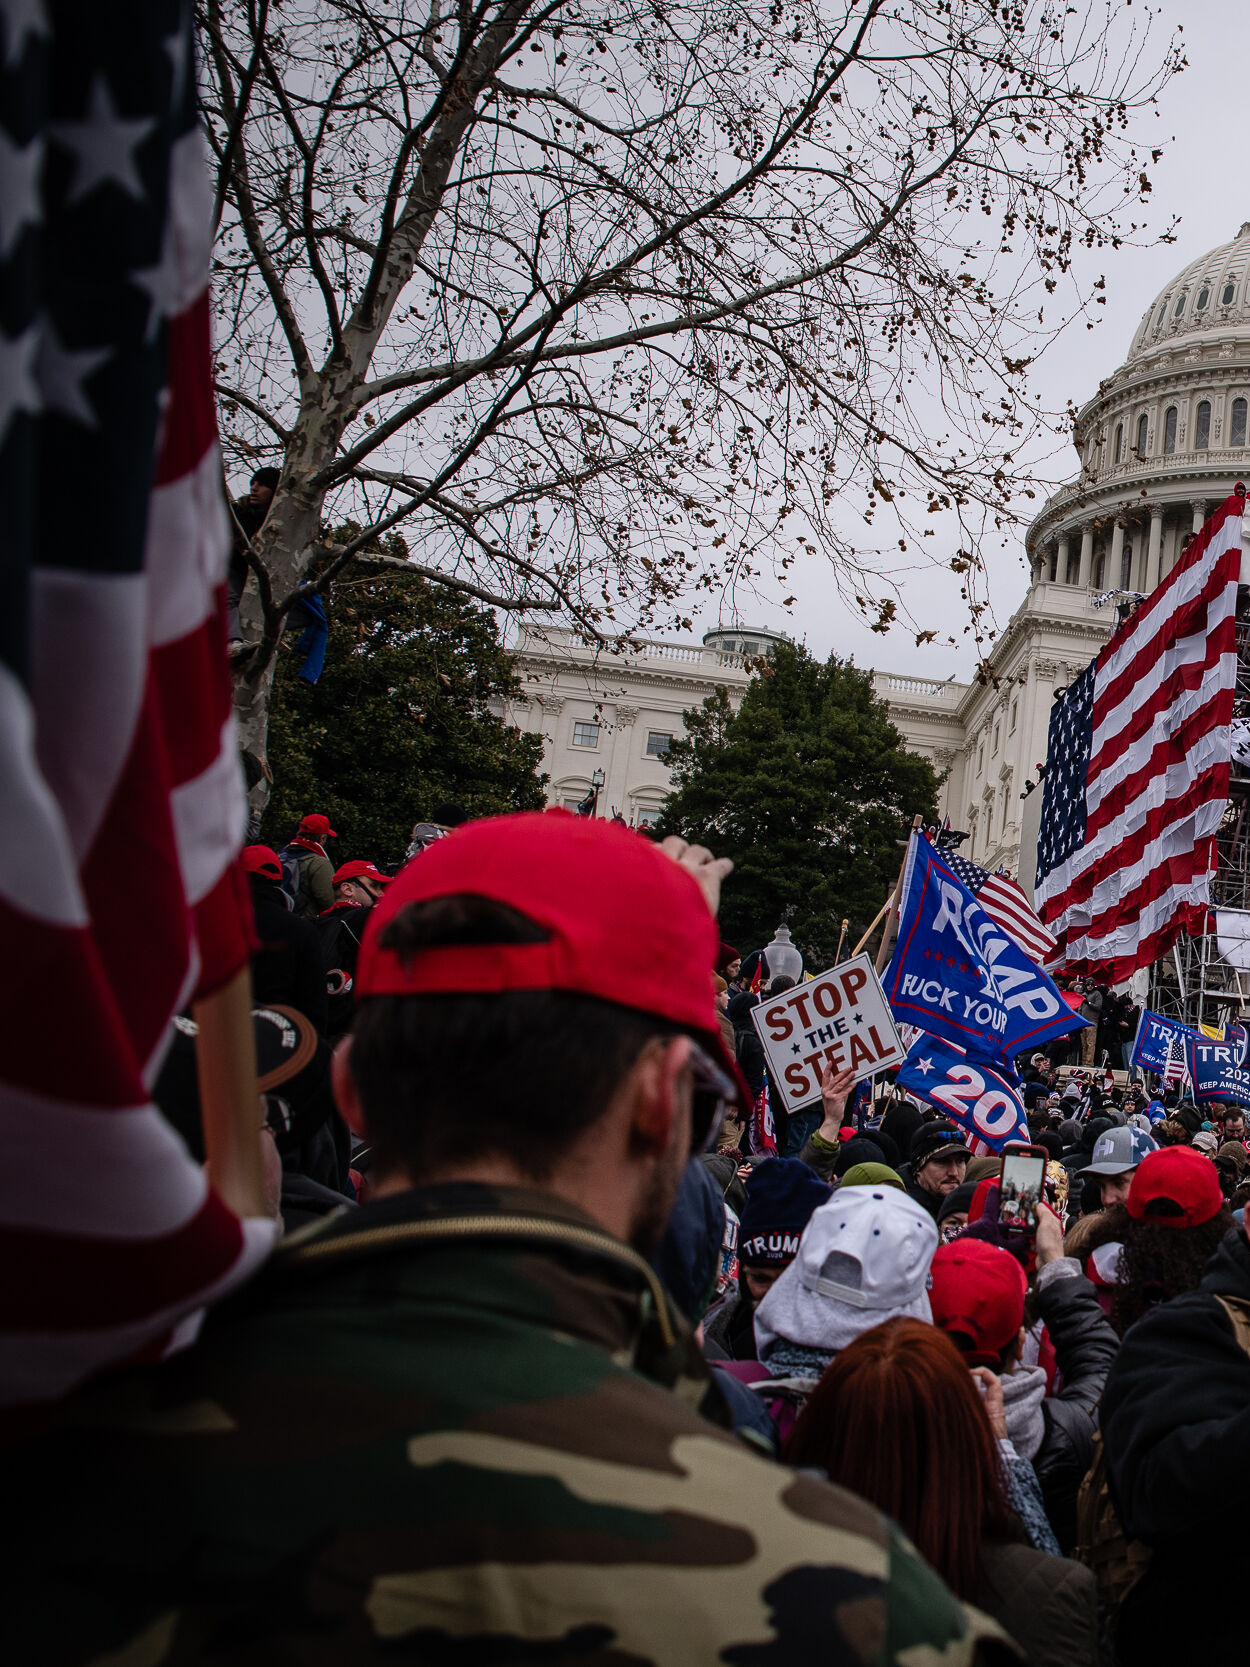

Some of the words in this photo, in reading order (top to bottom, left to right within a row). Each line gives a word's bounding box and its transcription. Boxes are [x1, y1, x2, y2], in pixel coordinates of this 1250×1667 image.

[765, 967, 868, 1042] STOP
[900, 973, 959, 1013] FUCK
[962, 994, 1009, 1035] YOUR
[804, 1016, 850, 1049] THE
[784, 1024, 897, 1098] STEAL
[1197, 1045, 1242, 1064] TRU
[1199, 1081, 1218, 1091] KEEP
[743, 1234, 800, 1257] TRUM
